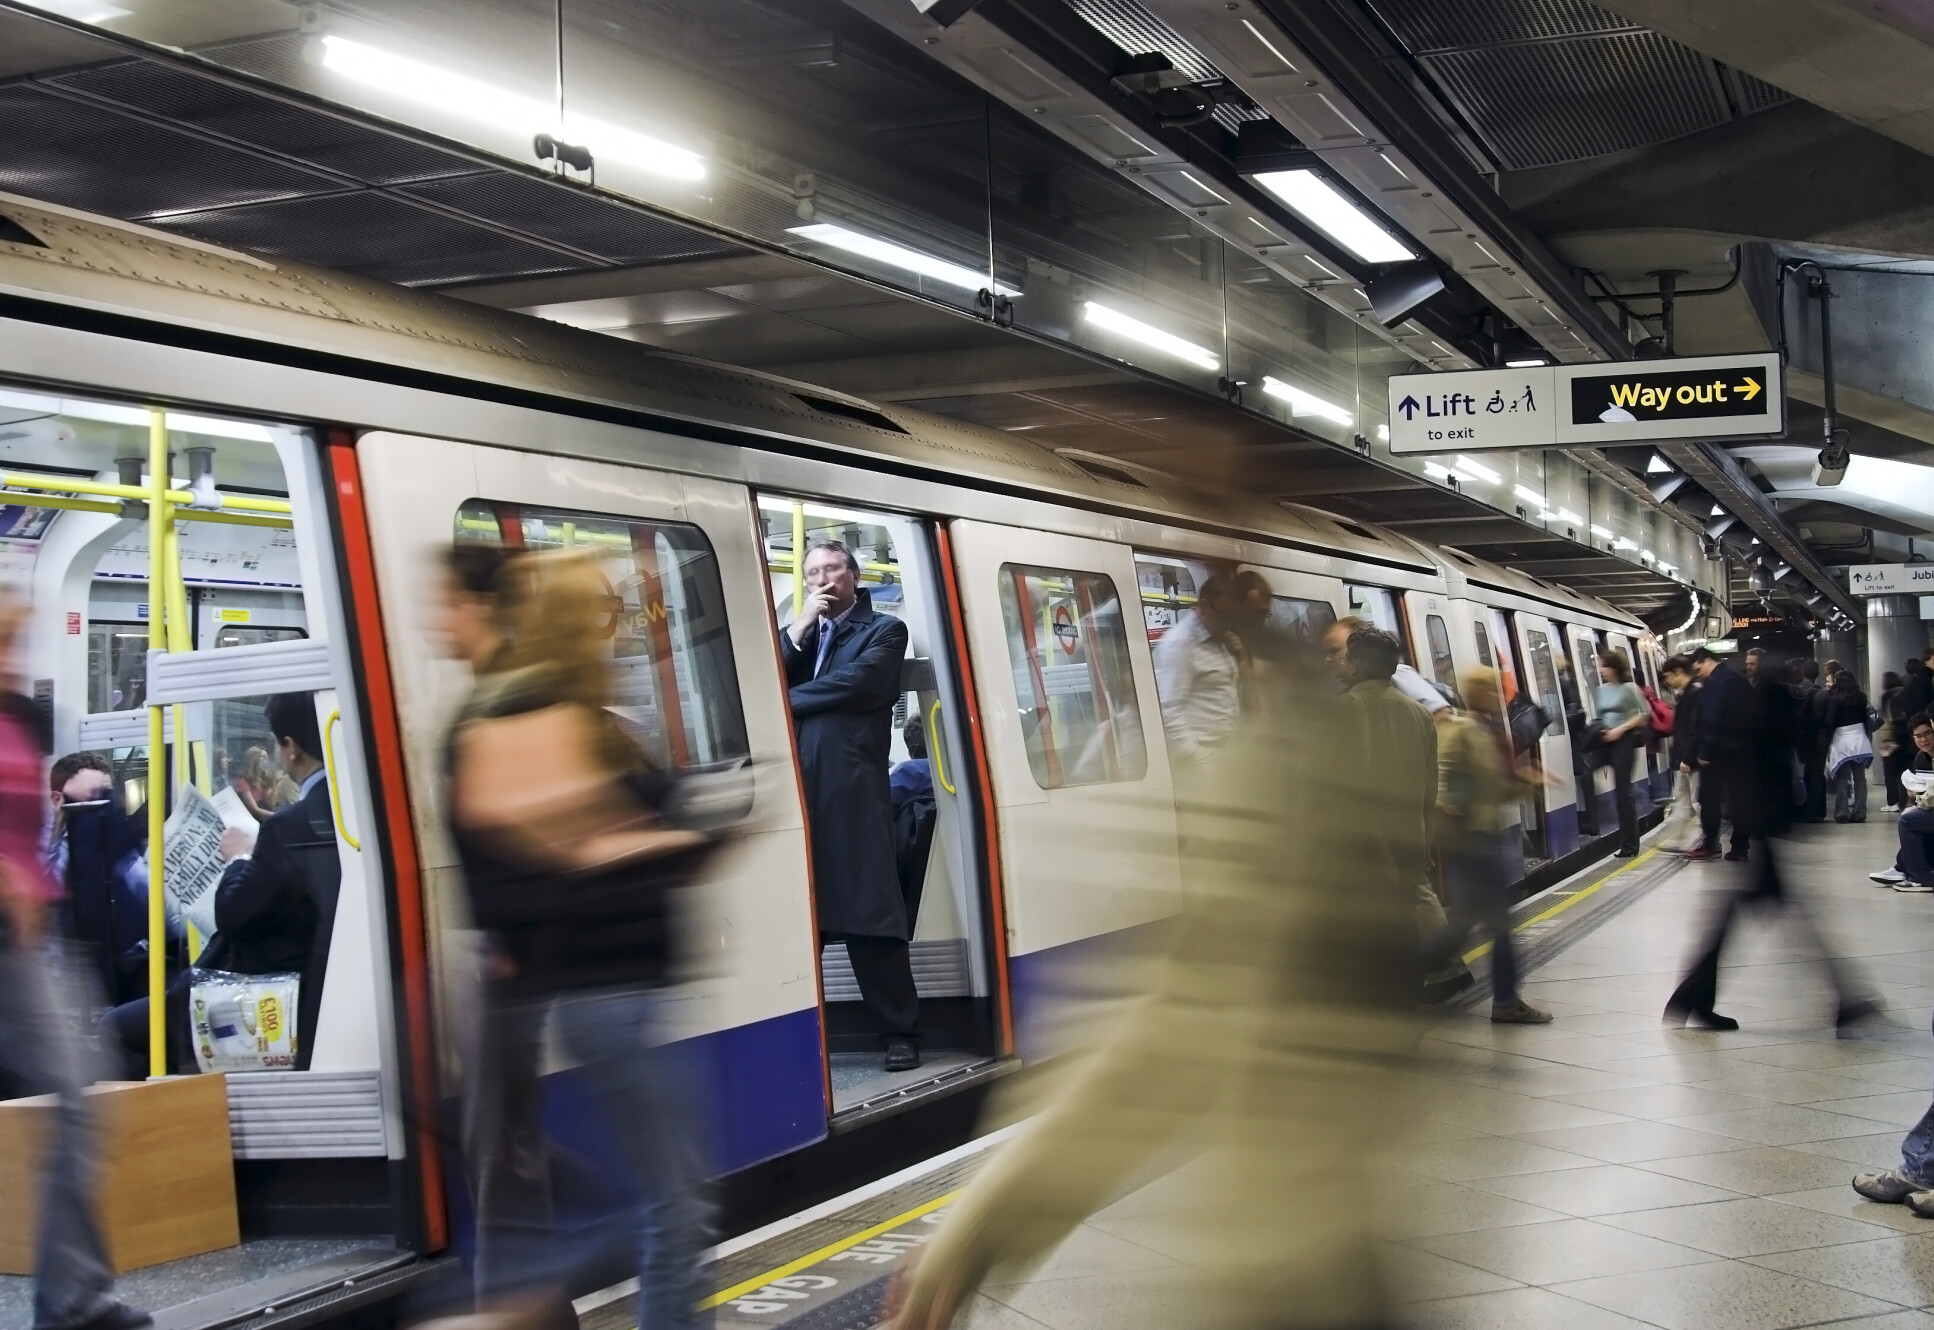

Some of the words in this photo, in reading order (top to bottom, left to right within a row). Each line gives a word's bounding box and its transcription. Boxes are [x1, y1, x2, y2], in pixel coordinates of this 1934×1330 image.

[1426, 393, 1476, 418] Lift
[1610, 382, 1672, 412] Way
[1676, 380, 1728, 405] out
[1428, 429, 1443, 441] to
[1447, 427, 1475, 440] exit
[168, 852, 205, 896] FAMILY
[179, 853, 227, 906] NIGHTMA
[264, 997, 279, 1031] £100
[726, 1274, 839, 1315] GAP
